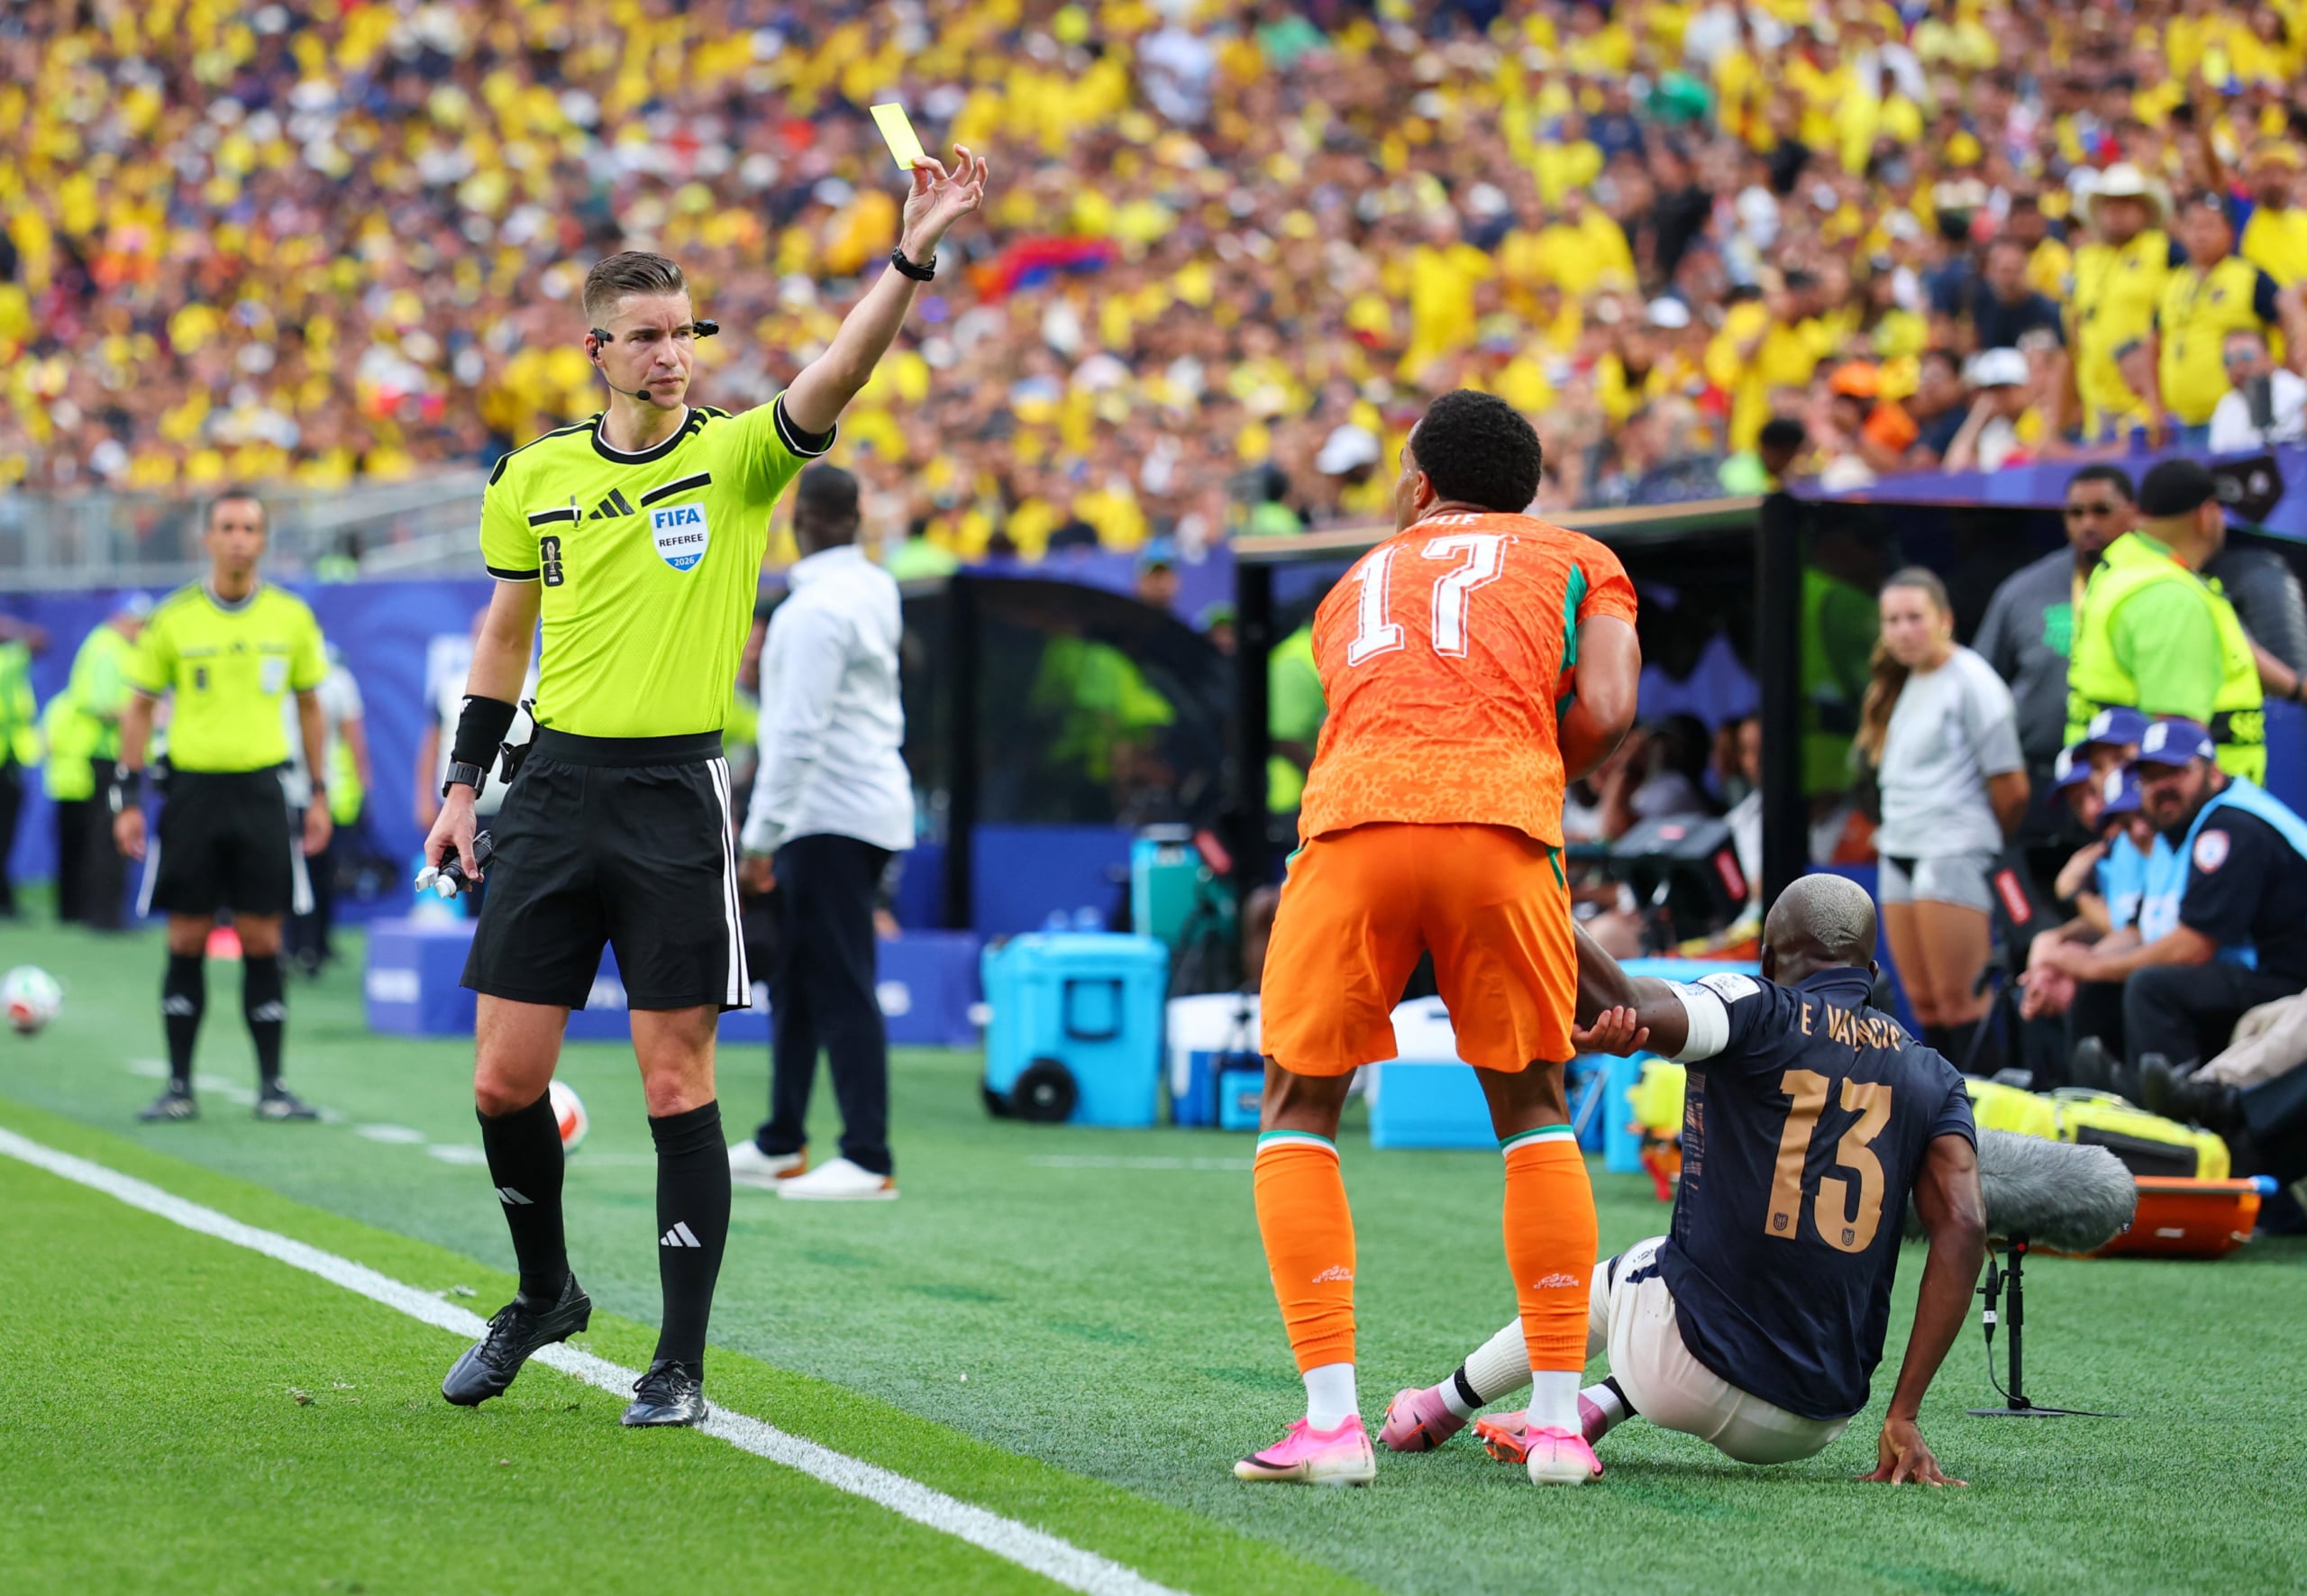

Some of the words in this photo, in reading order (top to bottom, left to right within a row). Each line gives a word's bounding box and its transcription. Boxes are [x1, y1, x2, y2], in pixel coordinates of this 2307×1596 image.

[655, 507, 701, 529] FIFA
[659, 533, 704, 547] REFEREE
[674, 556, 695, 567] 2026
[1348, 534, 1519, 667] 17
[1764, 1069, 1892, 1254] 13
